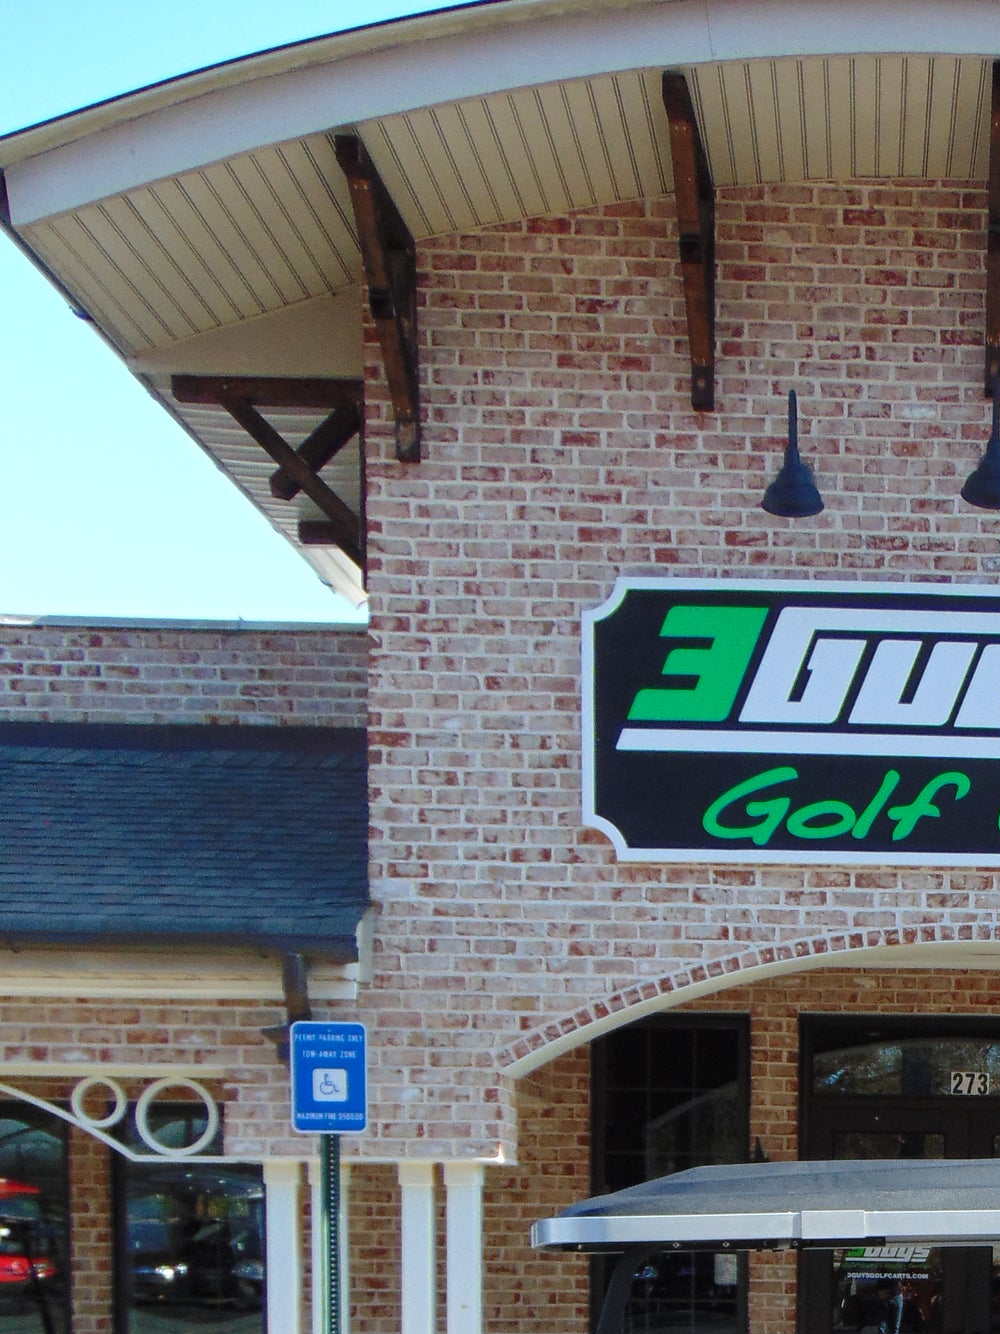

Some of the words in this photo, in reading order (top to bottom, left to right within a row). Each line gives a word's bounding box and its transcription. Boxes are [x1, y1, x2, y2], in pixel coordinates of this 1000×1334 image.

[628, 605, 770, 722] 3
[701, 766, 971, 846] Golf
[319, 1033, 345, 1042] PARKING
[347, 1033, 363, 1043] ONLY
[302, 1050, 337, 1058] TOW-AWAY
[340, 1050, 356, 1059] ZONE
[952, 1072, 988, 1095] 273
[846, 1272, 929, 1280] 3GUYSGOLFCARTS.COM
